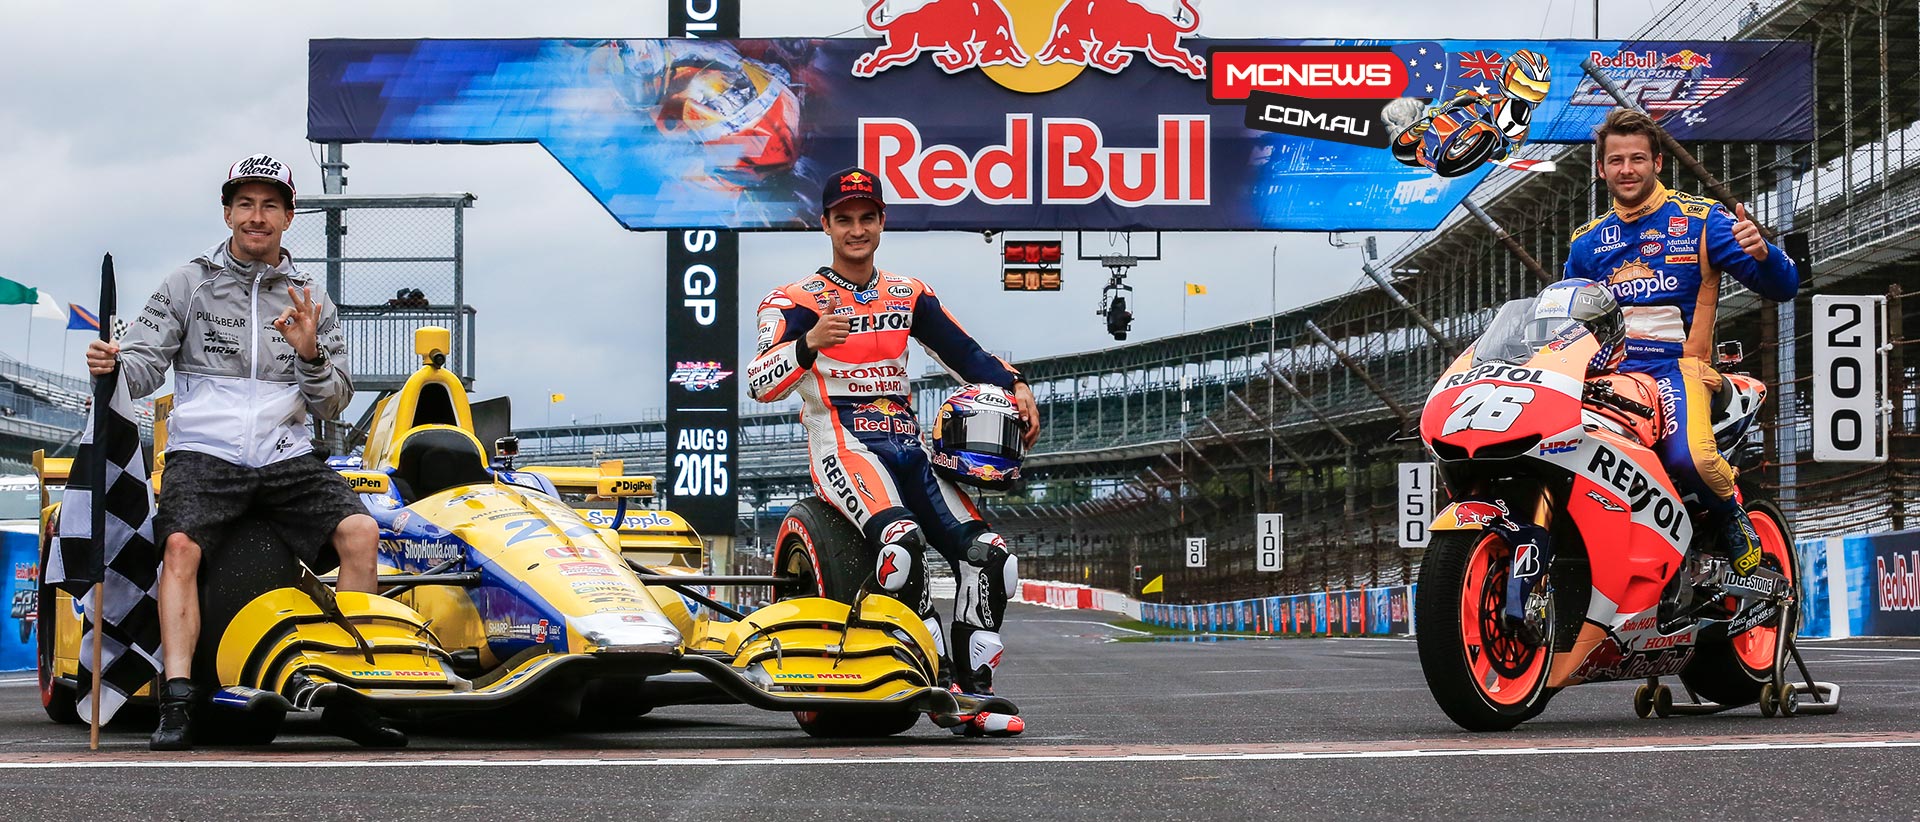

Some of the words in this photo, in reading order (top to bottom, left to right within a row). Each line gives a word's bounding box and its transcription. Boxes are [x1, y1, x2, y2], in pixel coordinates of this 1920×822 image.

[1590, 50, 1623, 68] Red
[1625, 51, 1657, 68] Bull
[1601, 69, 1687, 79] DIANAPOLIS
[858, 113, 1032, 206] Red
[1042, 114, 1211, 208] Bull
[841, 184, 857, 192] Red
[1640, 231, 1666, 240] Snapple
[1667, 237, 1690, 246] Mutual
[1691, 237, 1698, 245] of
[1593, 242, 1627, 254] HONDA
[1670, 245, 1694, 253] Omaha
[827, 271, 858, 292] REPSOL
[890, 286, 910, 294] Arai
[684, 264, 717, 326] GP
[885, 300, 911, 311] HRC
[136, 316, 160, 332] NDA
[196, 311, 246, 327] PULL&BEAR
[849, 313, 910, 333] EPSOL
[203, 345, 240, 355] MRW
[748, 366, 762, 378] Satu
[829, 365, 908, 379] HONDA
[1444, 365, 1543, 389] REPSOL
[1828, 304, 1862, 451] 200
[848, 382, 873, 392] One
[982, 393, 1007, 405] Arai
[1441, 382, 1536, 437] 26
[854, 416, 891, 432] Red
[893, 417, 916, 435] Bull
[677, 429, 714, 450] AUG
[717, 429, 728, 450] 9
[1540, 438, 1579, 456] HRC
[345, 477, 381, 488] igiPen
[674, 453, 728, 496] 2015
[622, 481, 653, 493] DigiPen
[822, 454, 864, 525] REPSOL
[1587, 444, 1688, 542] REPSOL
[1406, 468, 1424, 542] 150
[588, 511, 673, 528] Snapple
[405, 539, 458, 562] ShopHonda.com
[1190, 541, 1199, 564] 50
[1263, 520, 1275, 567] 100
[1724, 572, 1773, 593] IDGESTONE
[1877, 552, 1898, 611] Red
[488, 622, 508, 634] SHARP
[1643, 632, 1692, 650] HONDA
[1620, 650, 1664, 679] Red
